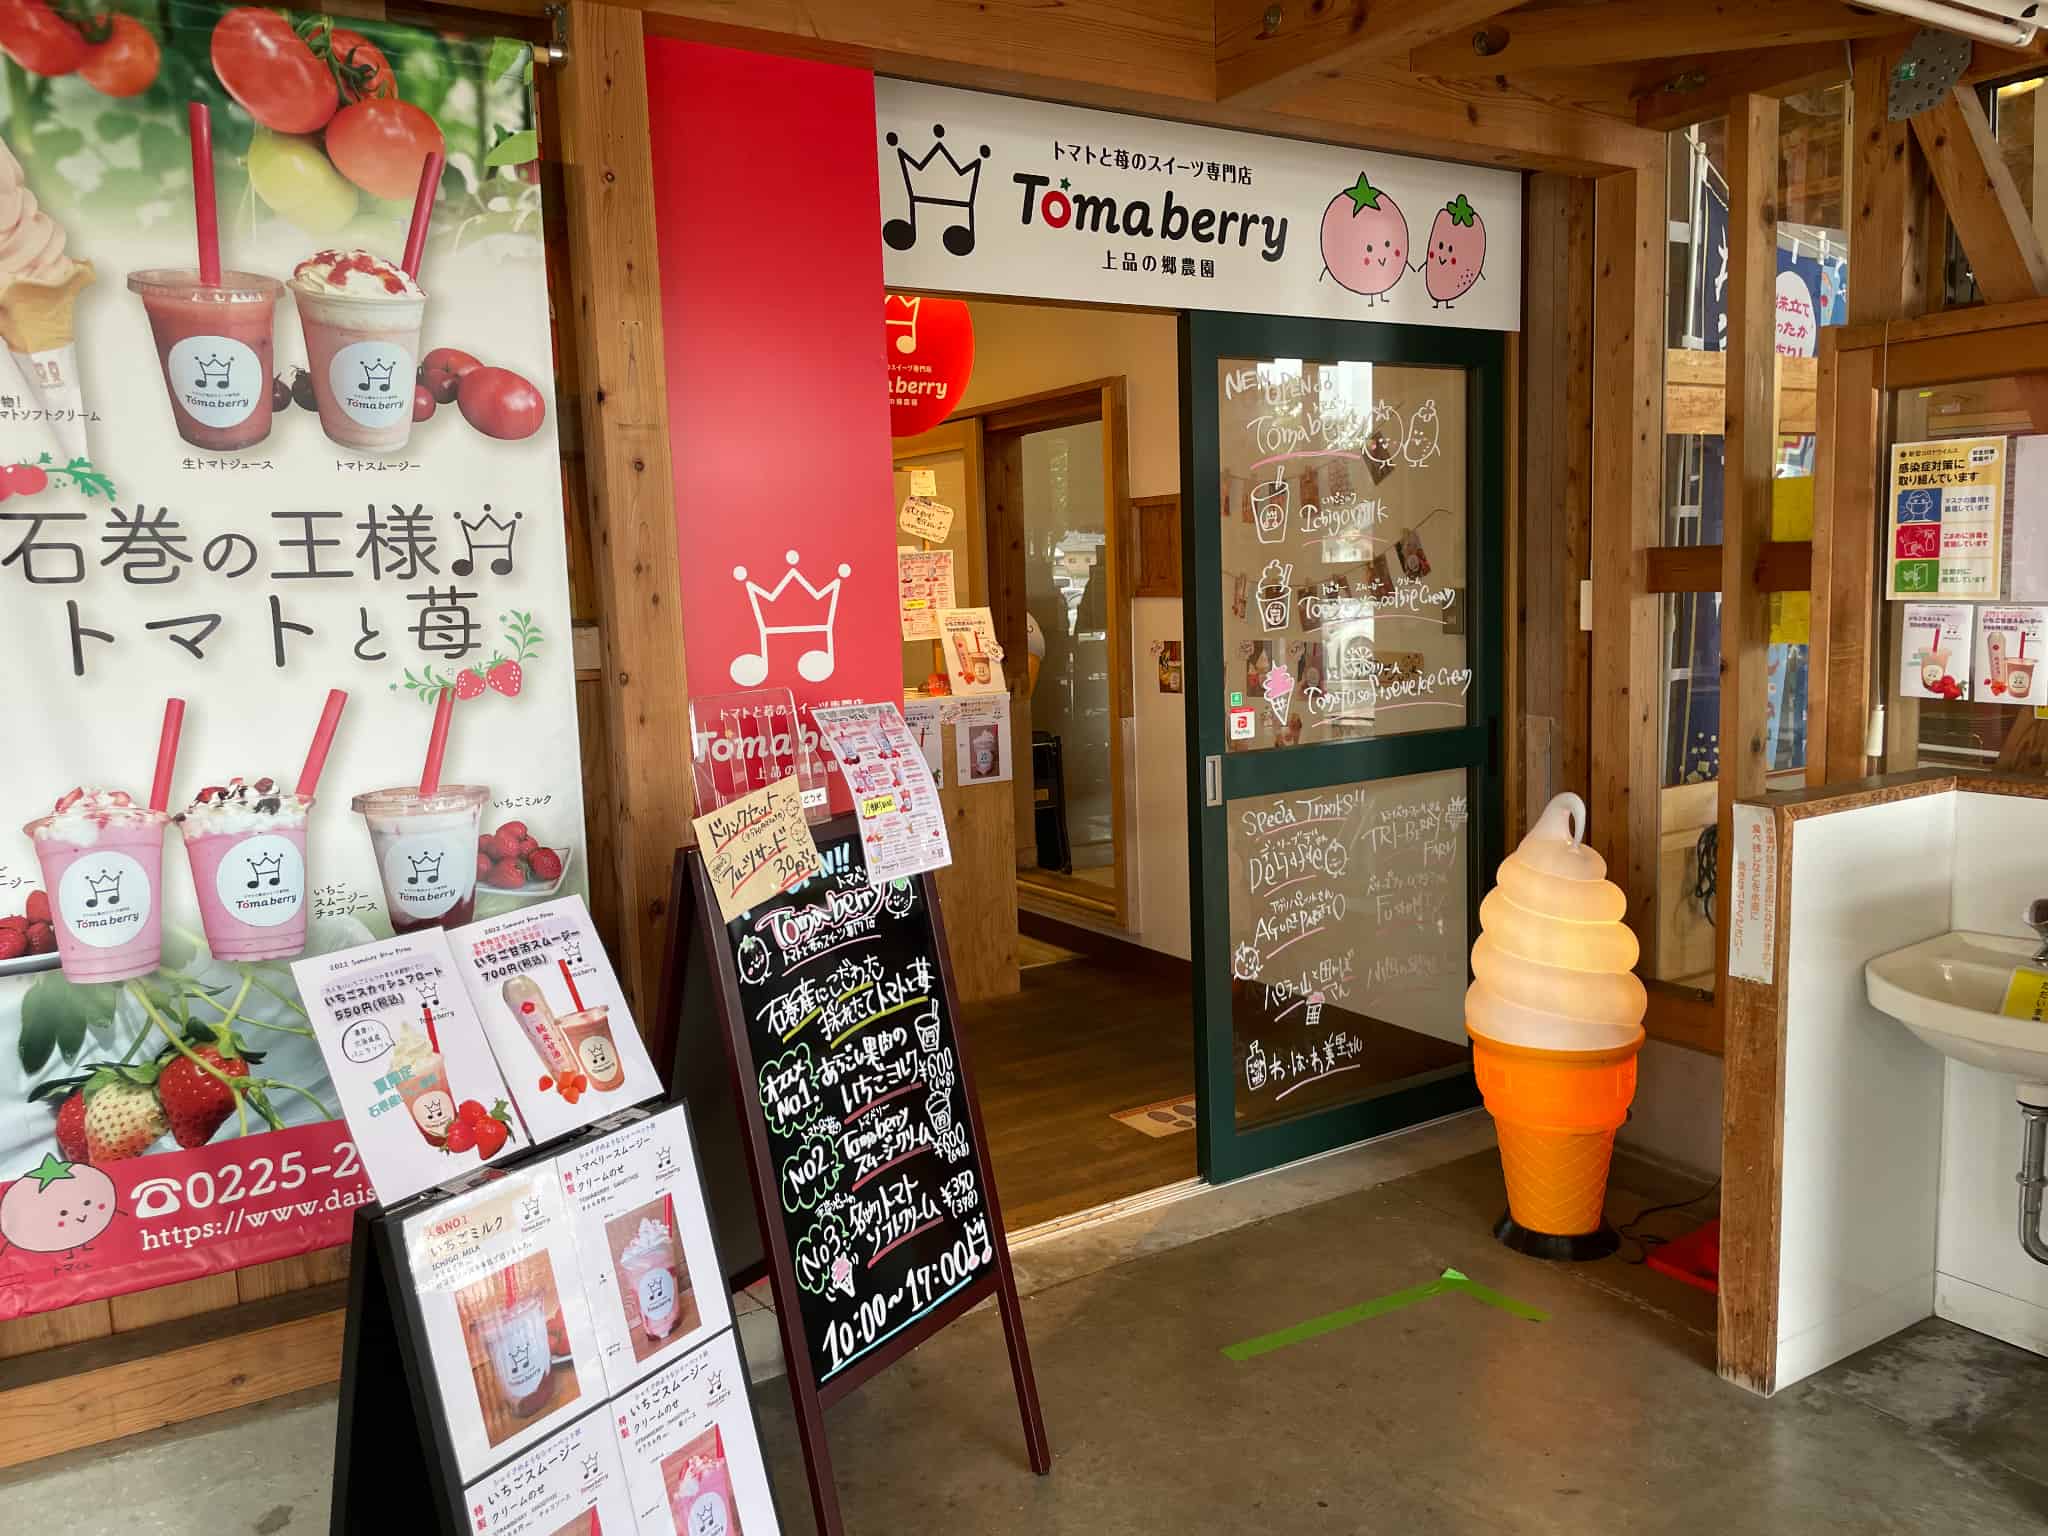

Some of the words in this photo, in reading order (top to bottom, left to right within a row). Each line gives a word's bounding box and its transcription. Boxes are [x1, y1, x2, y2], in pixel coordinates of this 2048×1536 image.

[1052, 140, 1254, 186] トマトと苺のスイーツ専門店
[1012, 172, 1289, 263] Tomaberry
[1101, 249, 1216, 280] 上品の郷農園
[182, 457, 275, 471] 生トマトジュース
[336, 461, 421, 472] トマトスムージー
[1898, 459, 1966, 474] 感染症対策に
[1898, 472, 1979, 486] 取り組んでいます
[0, 503, 441, 585] 石巻の王様
[66, 585, 483, 676] トマトと苺
[493, 794, 553, 810] いちごミルク
[313, 883, 346, 896] いちご
[314, 893, 369, 908] スムージー
[315, 902, 377, 920] チョコソース
[816, 1027, 908, 1087] あらごし果肉の
[840, 1049, 918, 1114] いちごミルク
[487, 1441, 581, 1507] いちごスムージー
